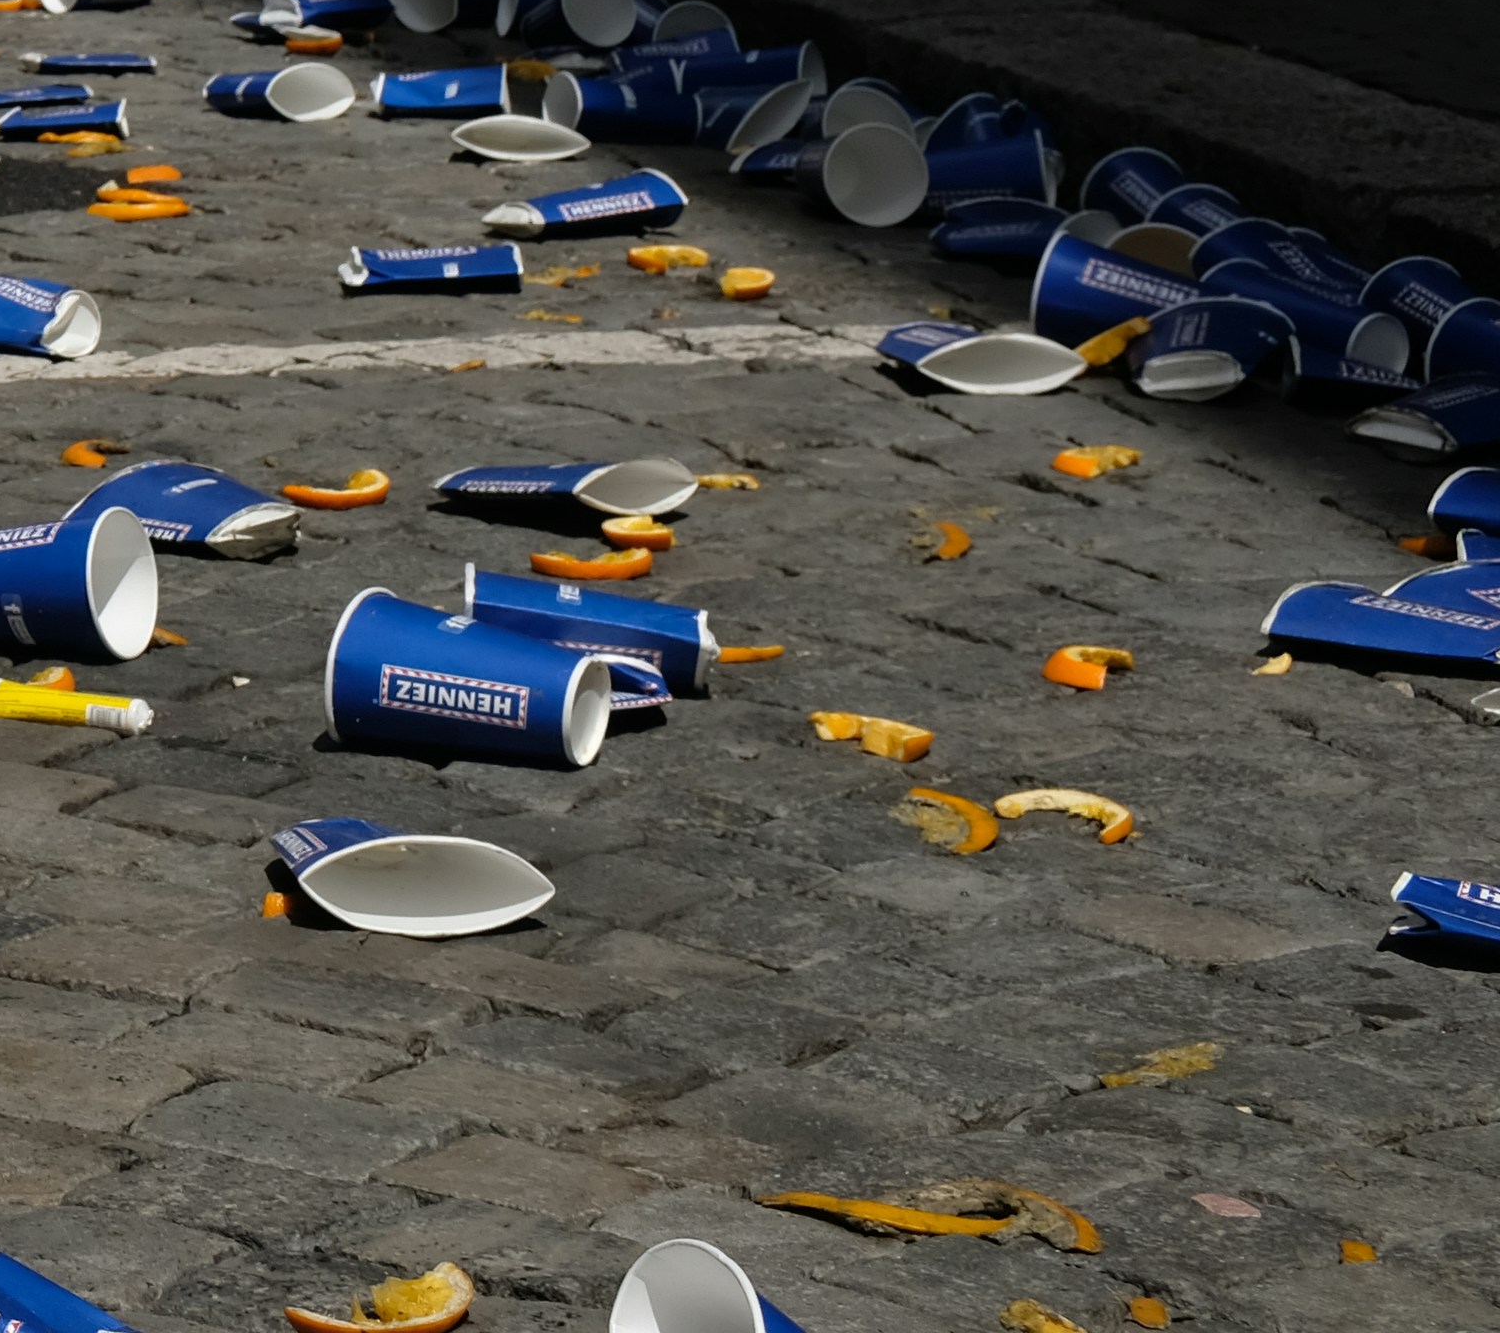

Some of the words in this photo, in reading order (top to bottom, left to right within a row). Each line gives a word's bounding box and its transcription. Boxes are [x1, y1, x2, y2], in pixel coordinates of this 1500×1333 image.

[571, 197, 642, 214] HENNIEZ
[1100, 267, 1195, 304] HENNIEZ
[1369, 597, 1486, 625] HENNIEZ
[395, 677, 511, 715] HENNIEZ
